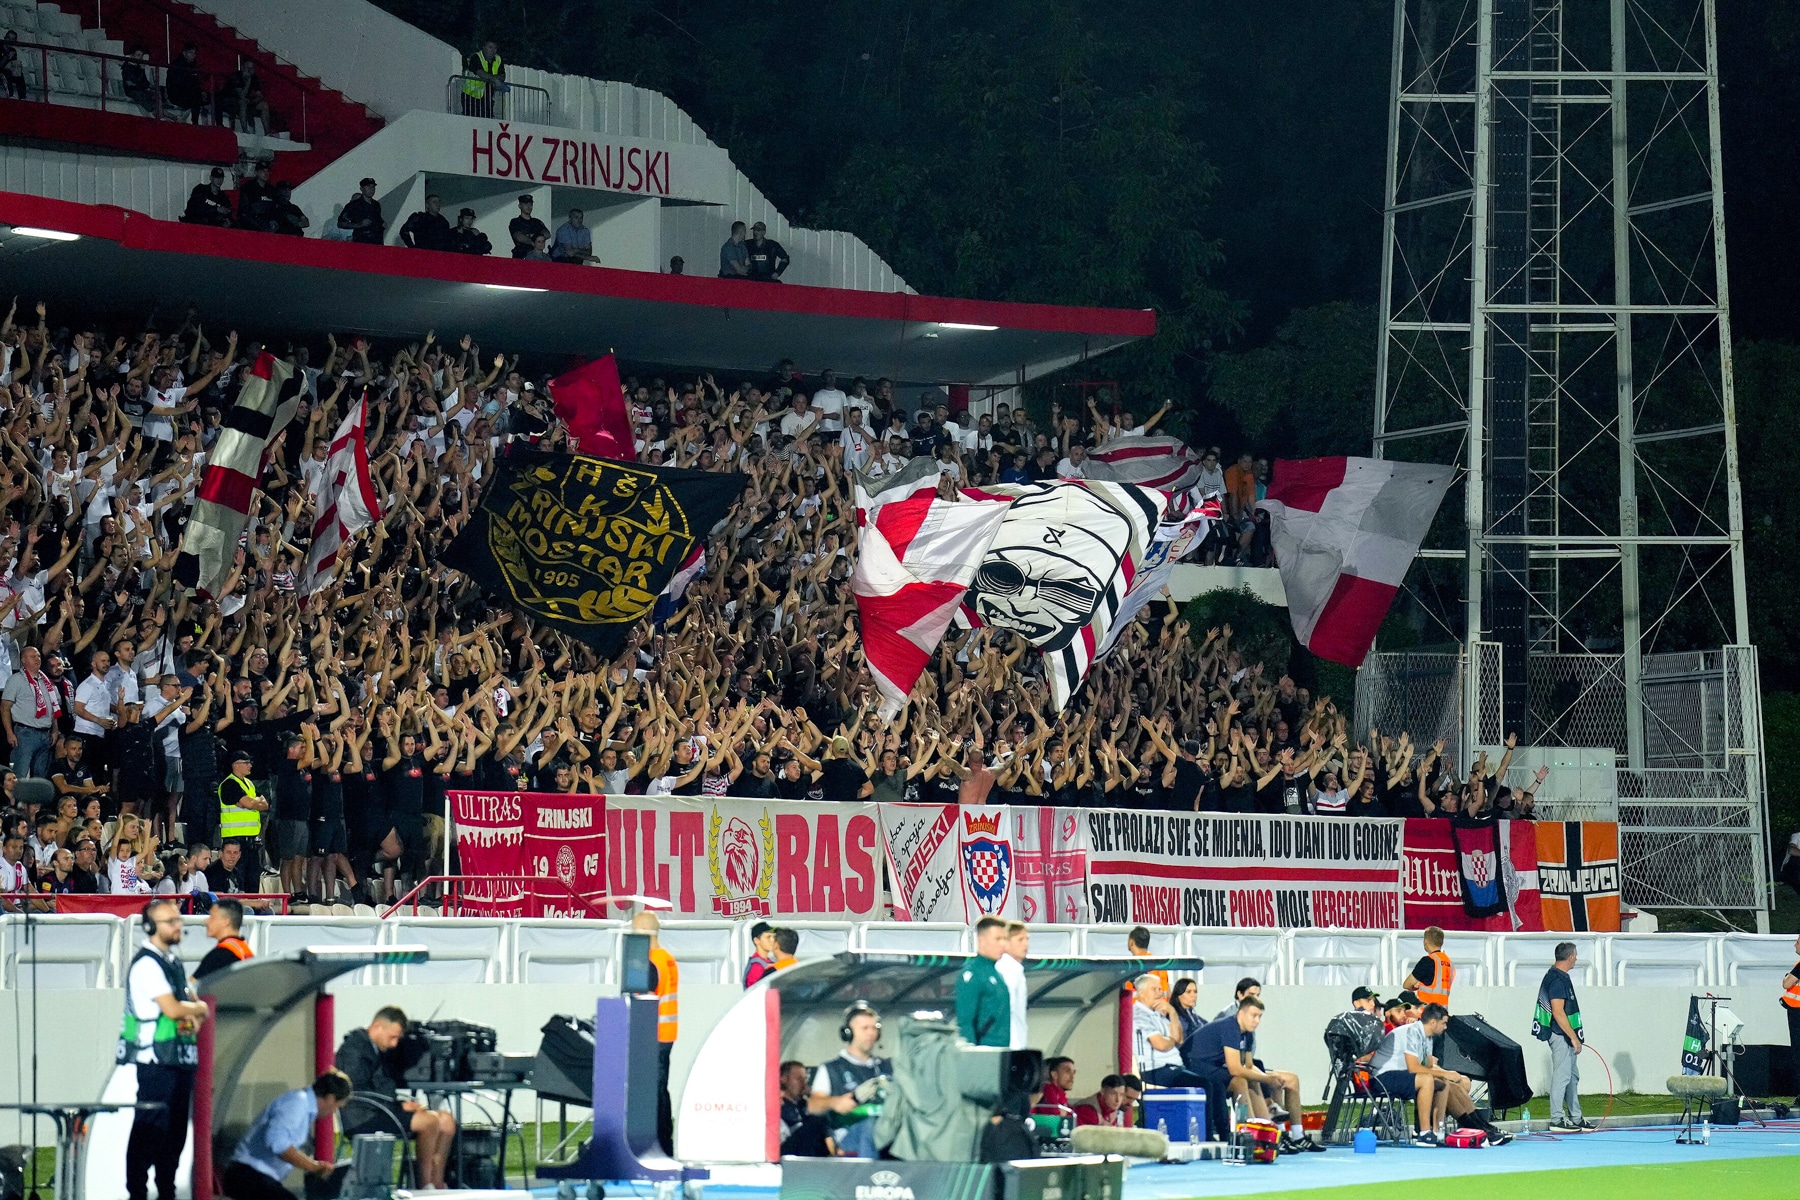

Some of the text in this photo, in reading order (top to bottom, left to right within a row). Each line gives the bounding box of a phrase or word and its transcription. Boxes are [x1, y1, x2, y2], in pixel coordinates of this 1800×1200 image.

[472, 123, 670, 195] HŠK ZRINJSKI
[507, 500, 652, 590] MOSTAR
[534, 568, 581, 588] 1905
[457, 794, 522, 824] ULTRAS
[536, 807, 593, 830] ZRINJSKI
[969, 822, 996, 832] ZRINJSKI
[1088, 812, 1399, 862] SVE PROLAZI SVE SE MIJENJA, IDU DANI IDU GODINE
[583, 853, 599, 877] 05
[1019, 862, 1072, 876] ULTRAS
[1540, 866, 1618, 893] ZRINJEVCI
[729, 899, 752, 915] 1994
[1090, 883, 1399, 929] SAMO ZRINJSKI OSTAJE PONOS MOJE HERCEGOVINE!
[855, 1185, 915, 1200] EUROPA
